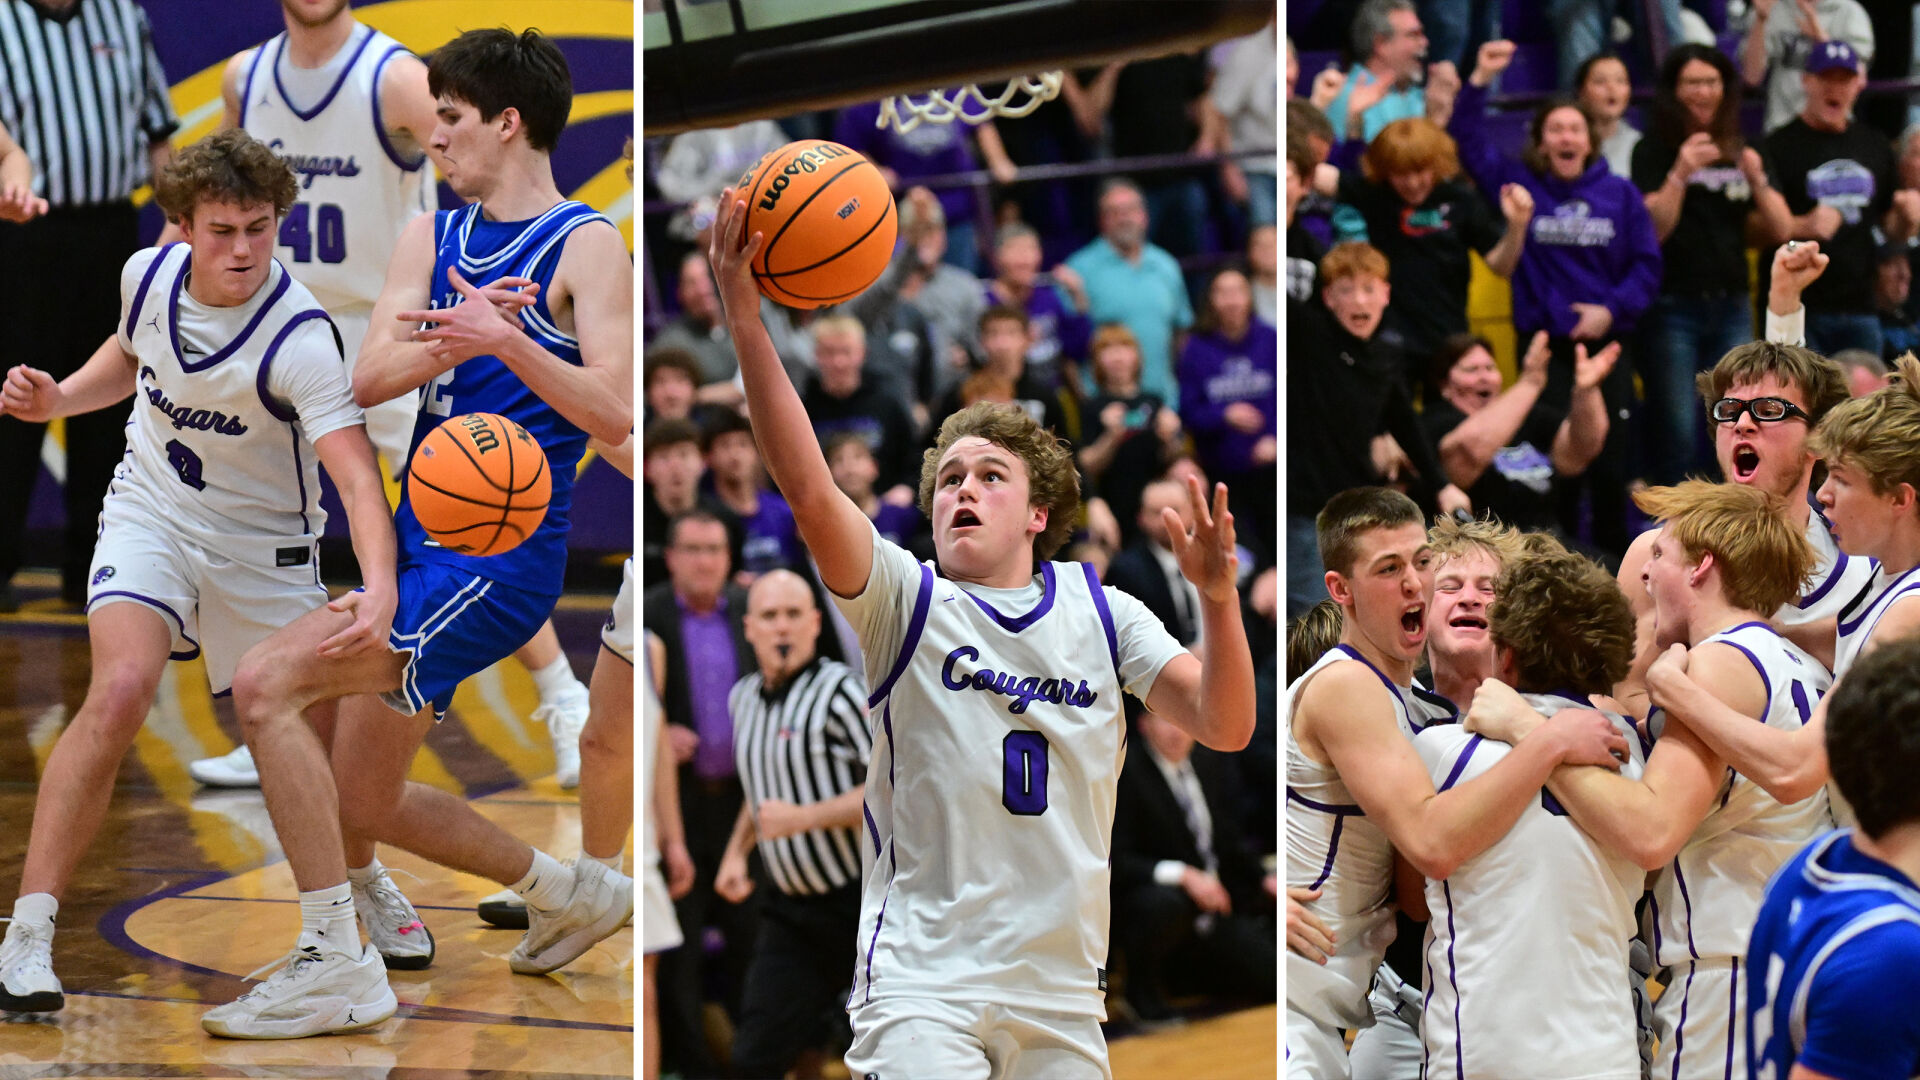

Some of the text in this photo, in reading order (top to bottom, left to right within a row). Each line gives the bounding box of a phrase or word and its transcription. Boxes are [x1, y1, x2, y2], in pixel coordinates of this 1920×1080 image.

[269, 137, 361, 189] ugars
[758, 143, 852, 212] Wilson
[278, 202, 347, 263] 40
[941, 645, 1098, 715] Cougars
[1002, 729, 1050, 817] 0
